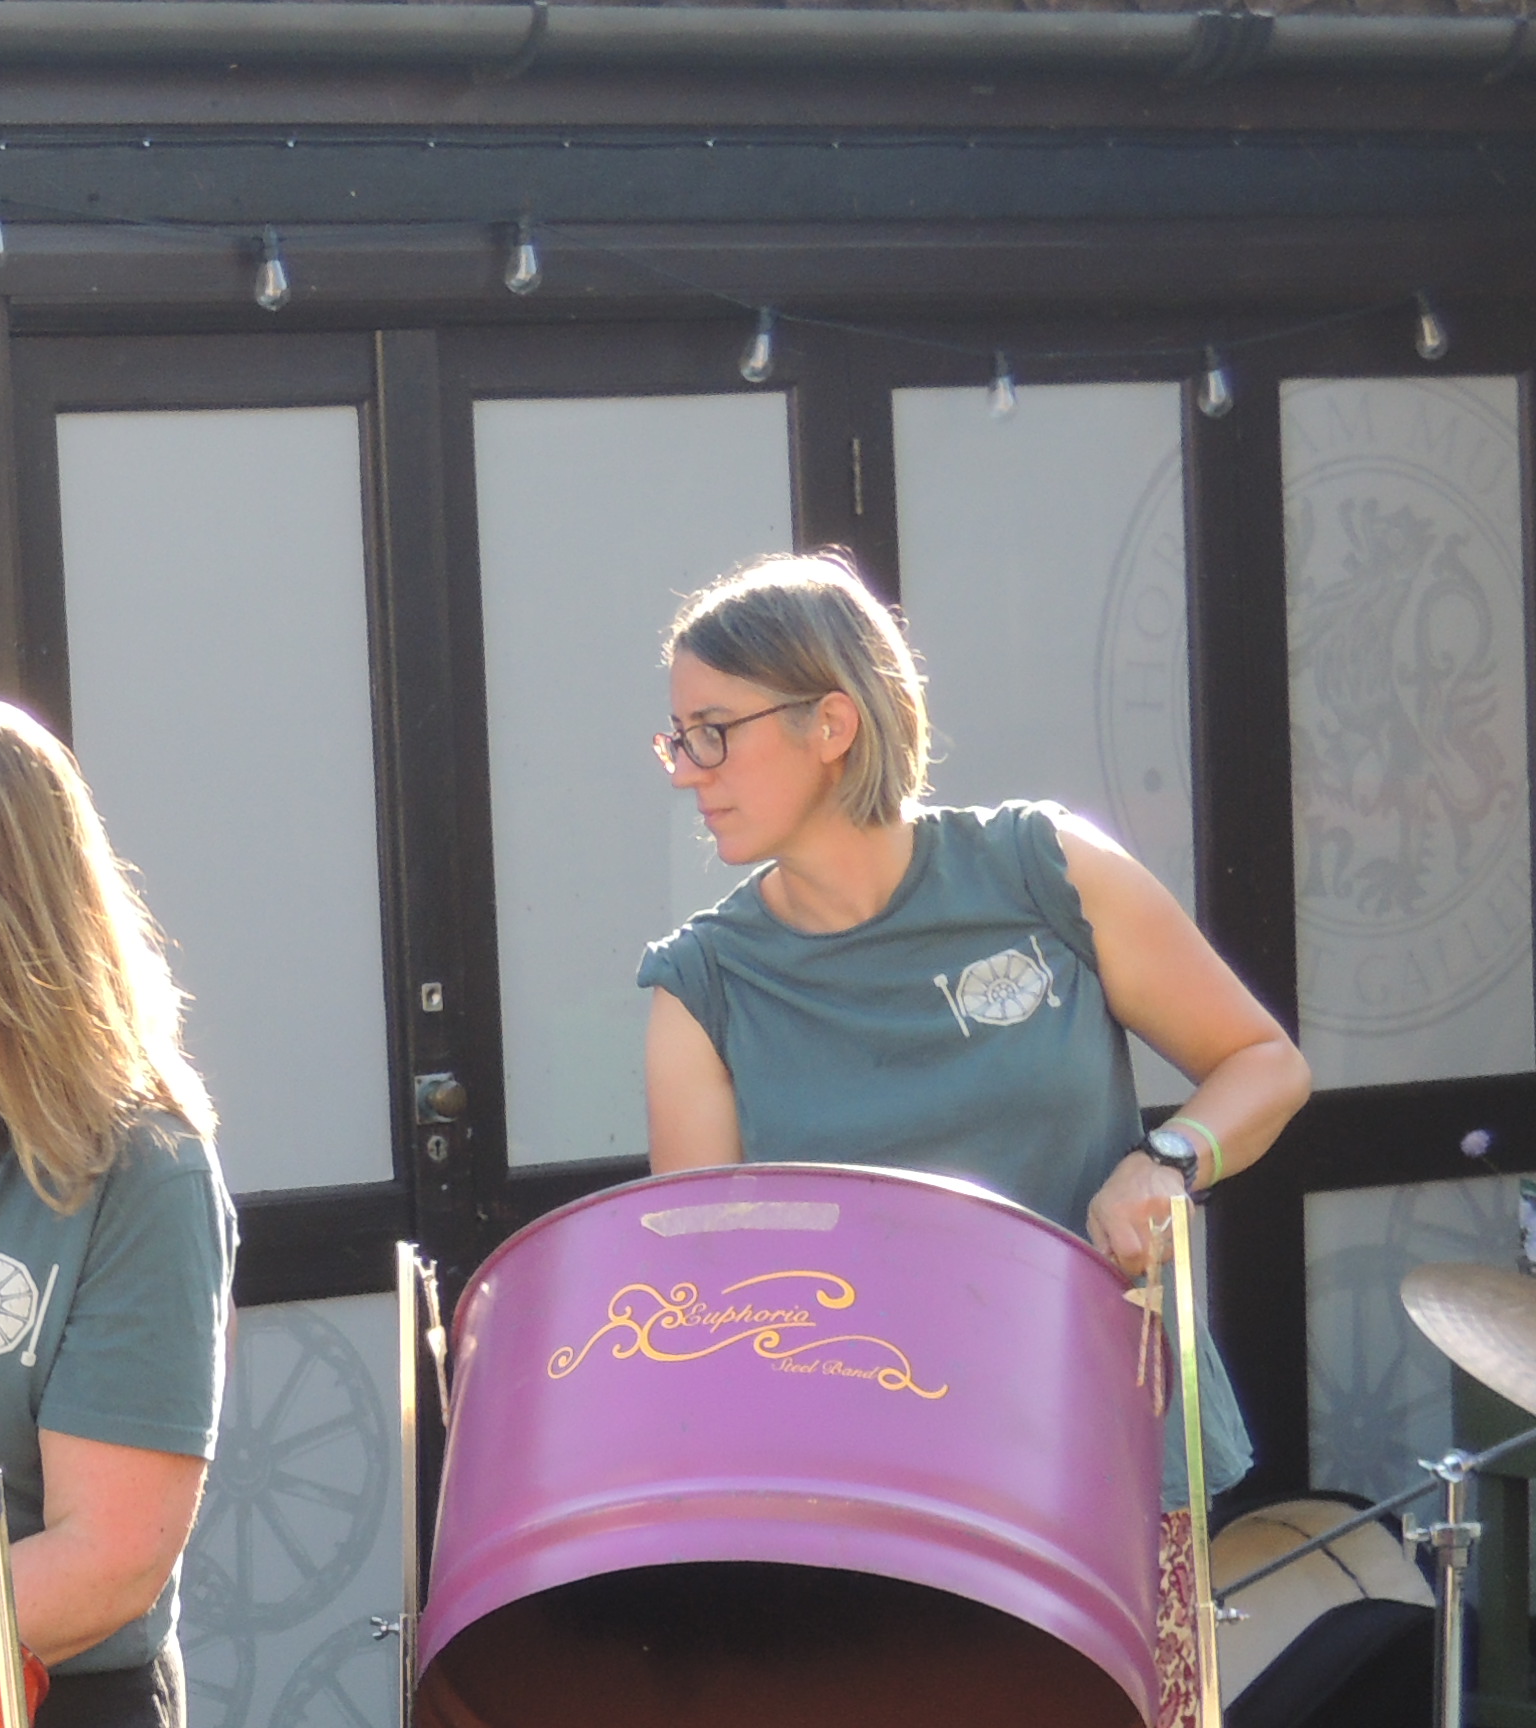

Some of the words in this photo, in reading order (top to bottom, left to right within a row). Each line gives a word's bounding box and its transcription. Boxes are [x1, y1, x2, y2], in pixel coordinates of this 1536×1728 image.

[682, 1302, 810, 1334] Euphoria
[772, 1357, 820, 1374] Steel
[822, 1360, 881, 1380] Band
